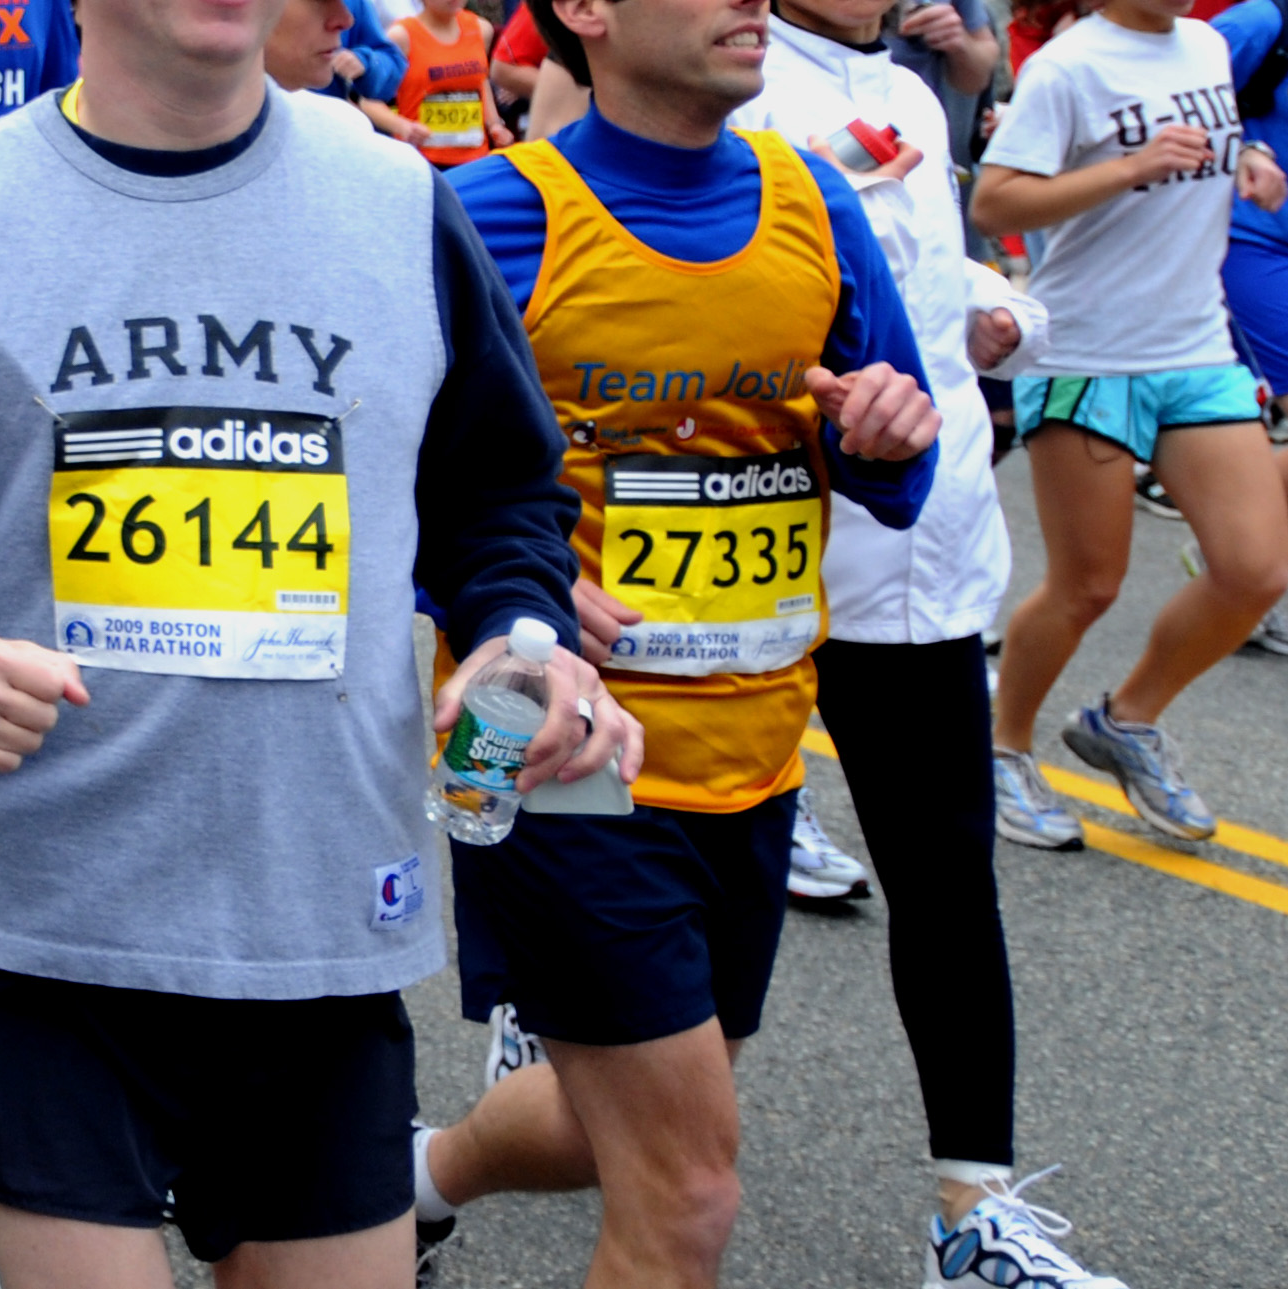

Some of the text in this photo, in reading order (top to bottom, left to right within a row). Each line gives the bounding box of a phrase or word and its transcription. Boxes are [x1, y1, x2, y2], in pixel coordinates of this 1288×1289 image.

[49, 314, 352, 397] ARMY
[574, 359, 805, 401] Team Josli
[169, 420, 329, 465] adidas
[704, 462, 811, 500] adidas
[66, 492, 334, 570] 26144
[617, 522, 808, 589] 27335
[105, 617, 221, 638] 2009 BOSTON
[105, 636, 222, 657] MARATHON
[648, 633, 740, 644] 2009 BOSTON
[646, 646, 740, 659] MARATHON
[468, 736, 525, 762] Sprin
